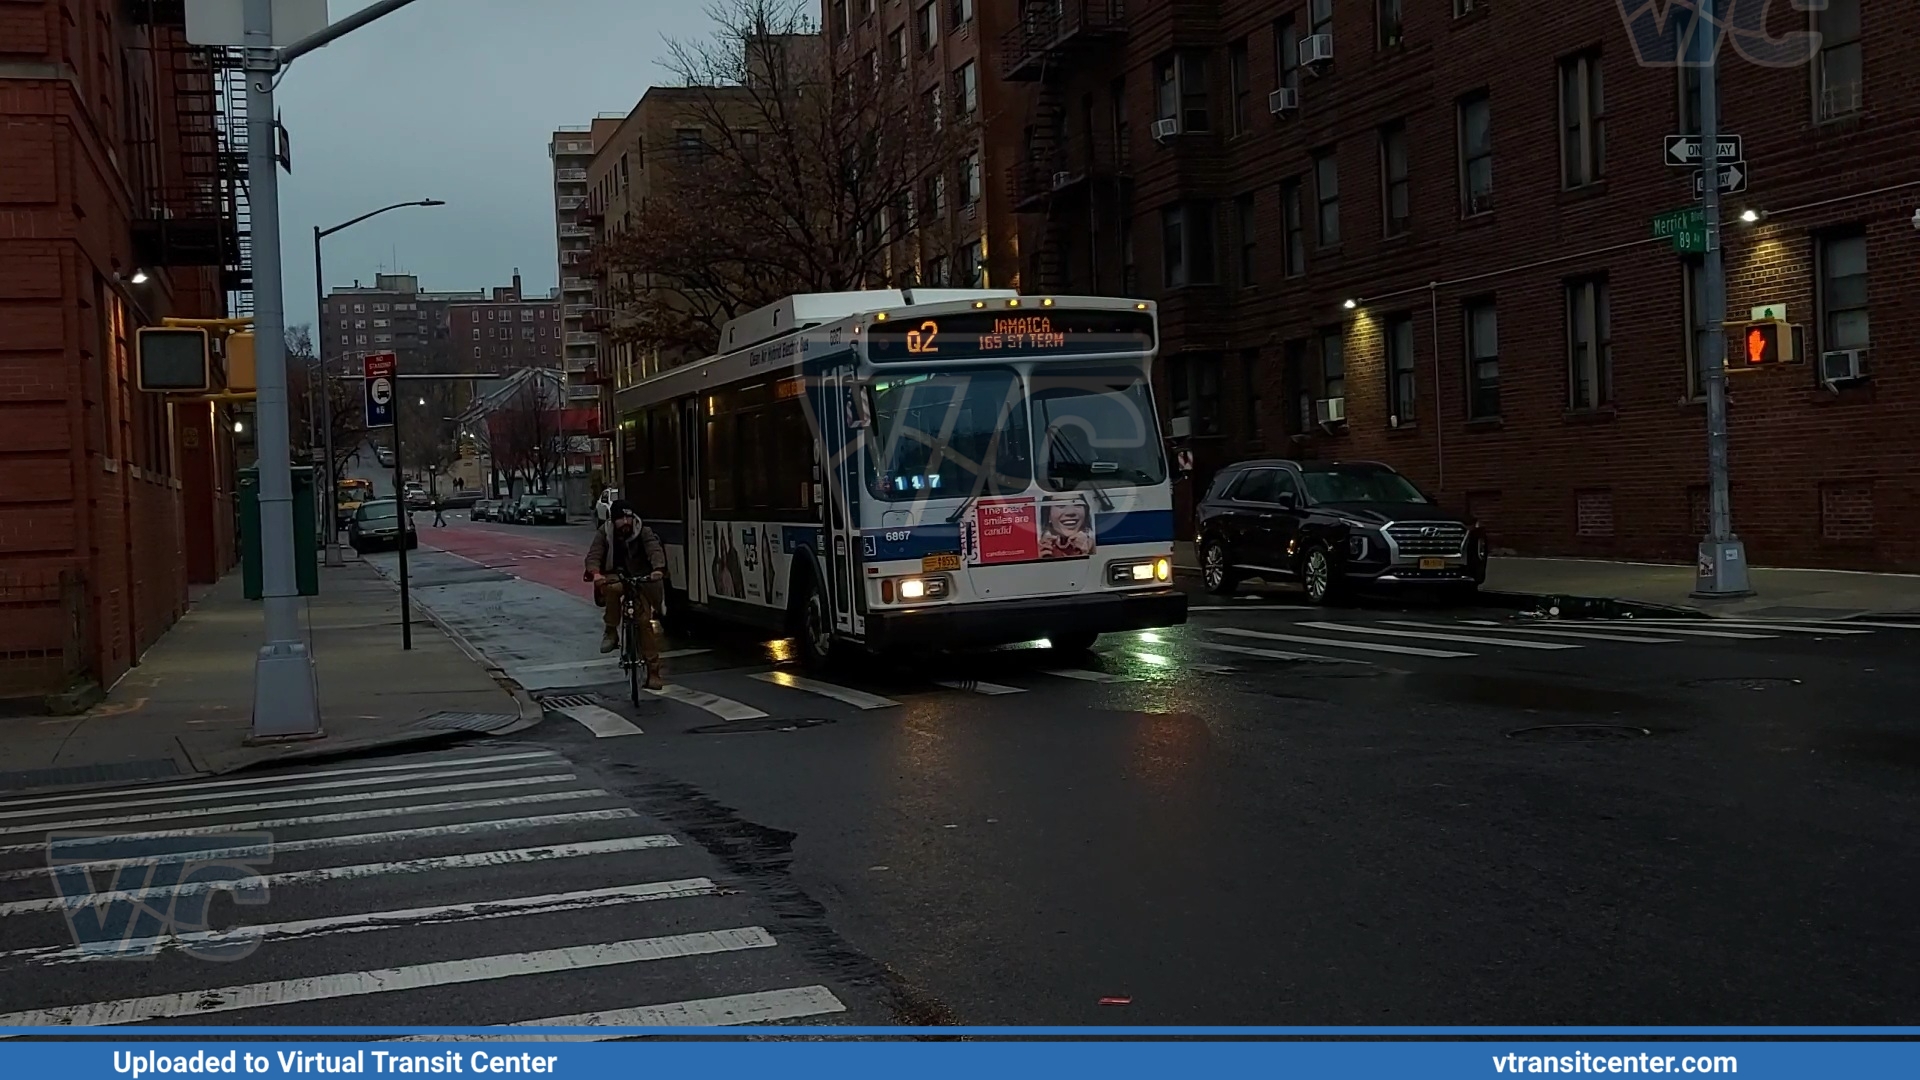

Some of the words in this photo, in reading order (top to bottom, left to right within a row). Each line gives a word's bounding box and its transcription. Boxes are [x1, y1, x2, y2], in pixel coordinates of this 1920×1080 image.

[1688, 144, 1703, 156] ON
[1654, 212, 1688, 235] Merrick
[1679, 231, 1691, 248] 89
[992, 316, 1051, 335] JAMAICA
[906, 320, 939, 353] Q2
[979, 334, 1002, 350] 165
[1007, 334, 1024, 348] ST
[1029, 332, 1065, 348] TERM
[983, 515, 1013, 526] smiles
[1015, 515, 1030, 524] are
[885, 530, 912, 542] 6867
[983, 525, 1013, 536] candid
